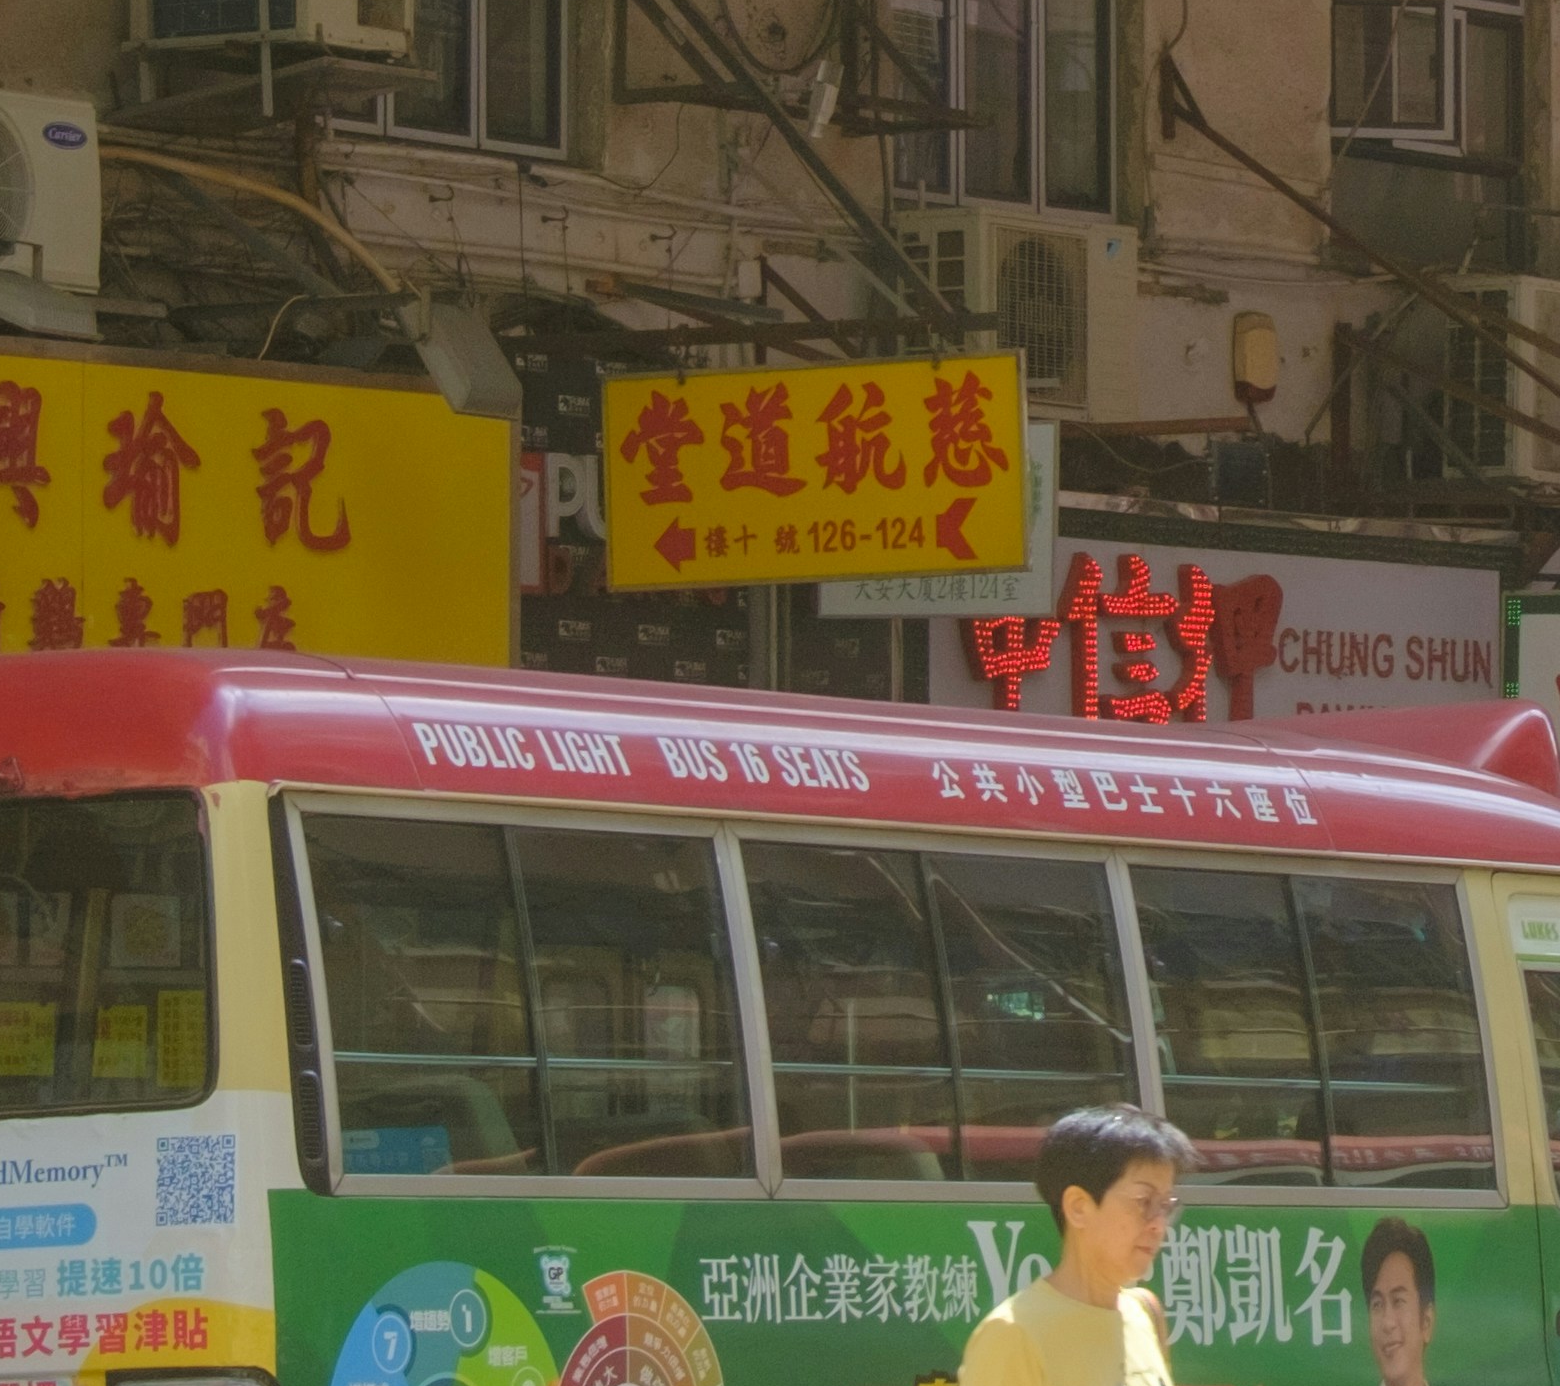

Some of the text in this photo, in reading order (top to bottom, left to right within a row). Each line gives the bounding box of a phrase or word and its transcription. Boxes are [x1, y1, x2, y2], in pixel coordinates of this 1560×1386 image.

[1278, 628, 1493, 688] CHUNG SHUN
[412, 721, 871, 793] PUBLIC LIGHT BUS 16 SEATS
[931, 759, 1318, 826] 公共小型巴士十六座位
[699, 1252, 982, 1324] 亞洲企業家教練
